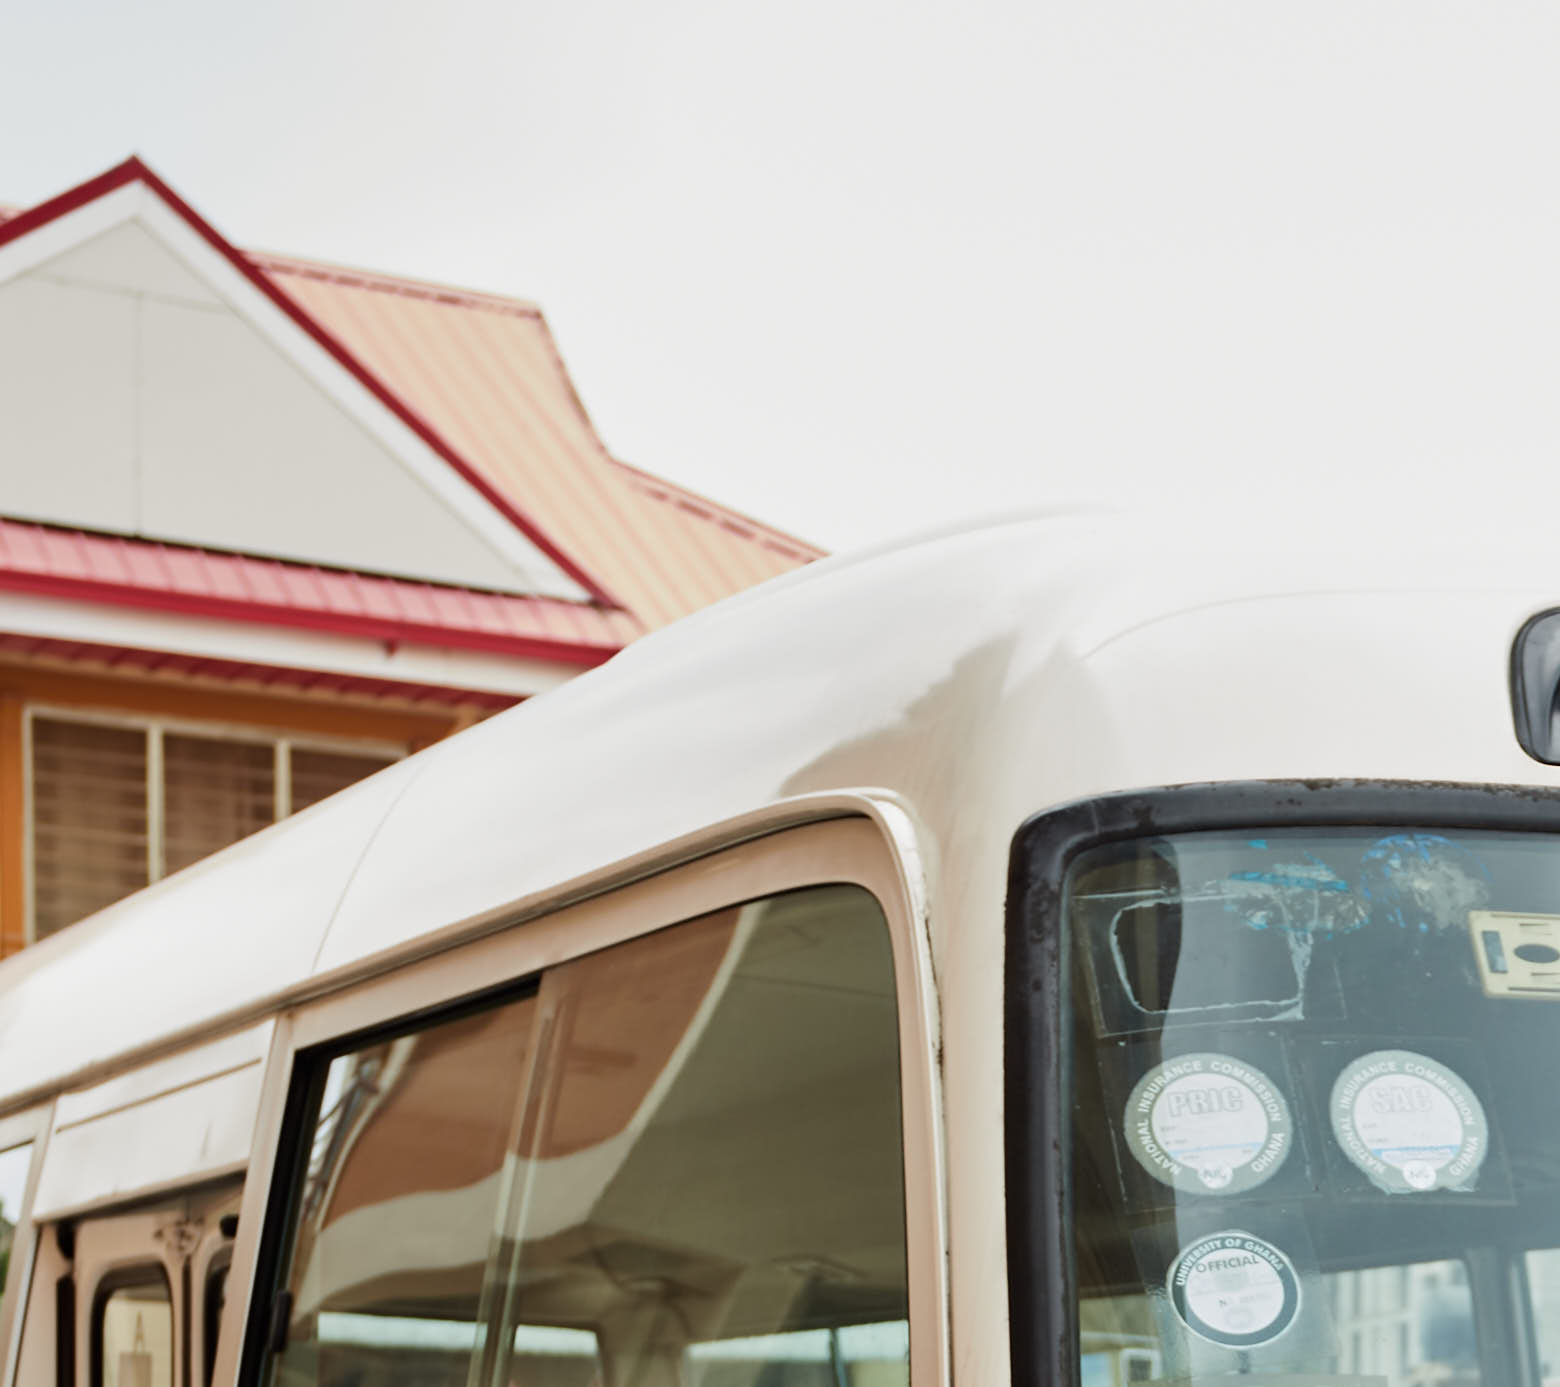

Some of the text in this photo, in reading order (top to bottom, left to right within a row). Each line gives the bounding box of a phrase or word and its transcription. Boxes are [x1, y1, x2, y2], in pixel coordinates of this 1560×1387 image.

[1137, 1060, 1285, 1175] NATIONAL INSURANCE COMMISSION GHANA
[1166, 1086, 1243, 1118] PRIC
[1339, 1061, 1479, 1177] NATIONAL INSURANCE COMMISSION GHANA
[1175, 1238, 1284, 1286] UNIVERSITY OF GHANA
[1195, 1254, 1260, 1273] OFFICIAL
